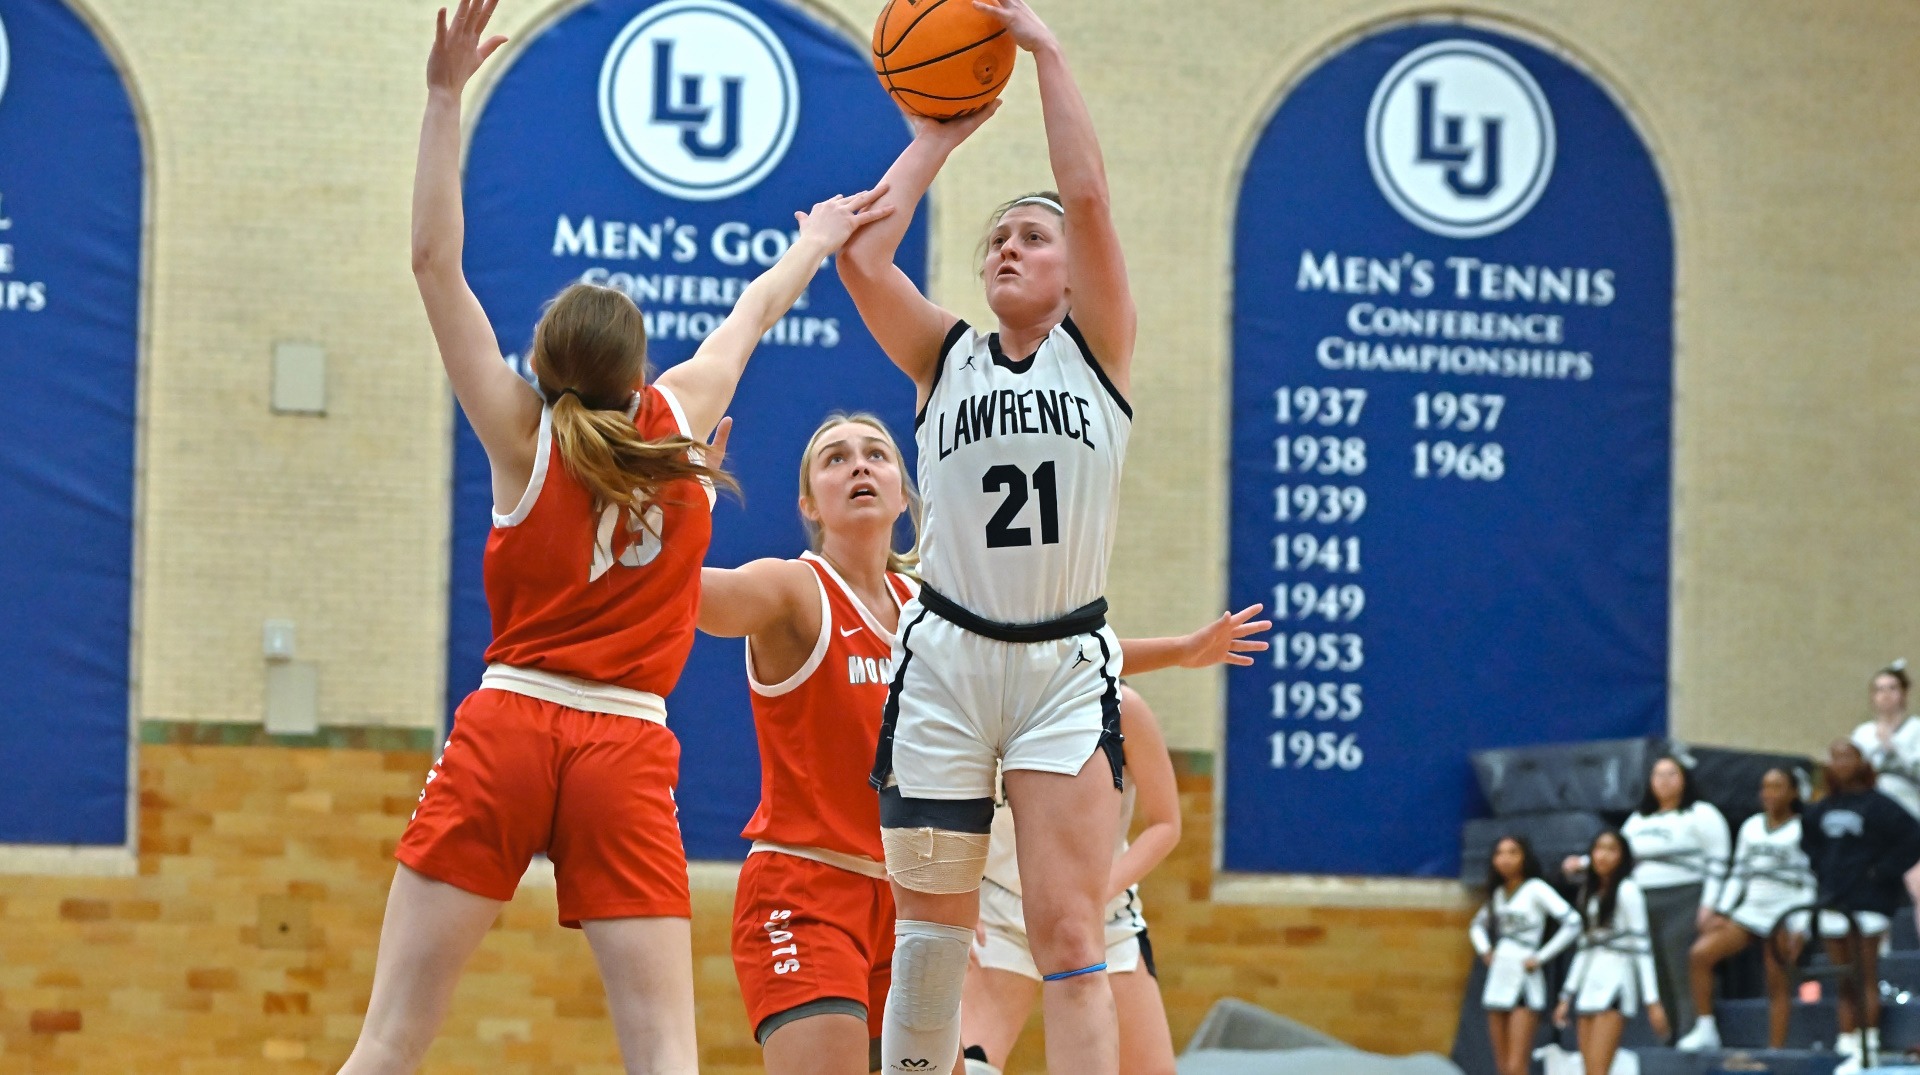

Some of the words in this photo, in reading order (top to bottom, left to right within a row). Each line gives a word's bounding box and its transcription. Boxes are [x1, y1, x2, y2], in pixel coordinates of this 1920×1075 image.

[552, 214, 698, 263] MEN'S
[711, 221, 829, 268] GO
[1296, 249, 1435, 298] MEN'S
[1445, 256, 1616, 306] TENNIS
[1346, 302, 1565, 344] CONFERENCE
[1316, 336, 1594, 381] CHAMPIONSHIPS
[938, 389, 1095, 461] LAWRENCE
[1273, 385, 1368, 427] 1937
[1413, 391, 1506, 432] 1957
[1273, 434, 1367, 476] 1938
[1413, 440, 1505, 481] 1968
[981, 460, 1059, 548] 21
[1273, 483, 1367, 524] 1939
[1271, 532, 1361, 573] 1941
[1272, 582, 1366, 622] 1949
[1271, 631, 1364, 672] 1953
[1269, 681, 1363, 721] 1955
[1267, 730, 1364, 771] 1956
[764, 909, 801, 975] SCOTS
